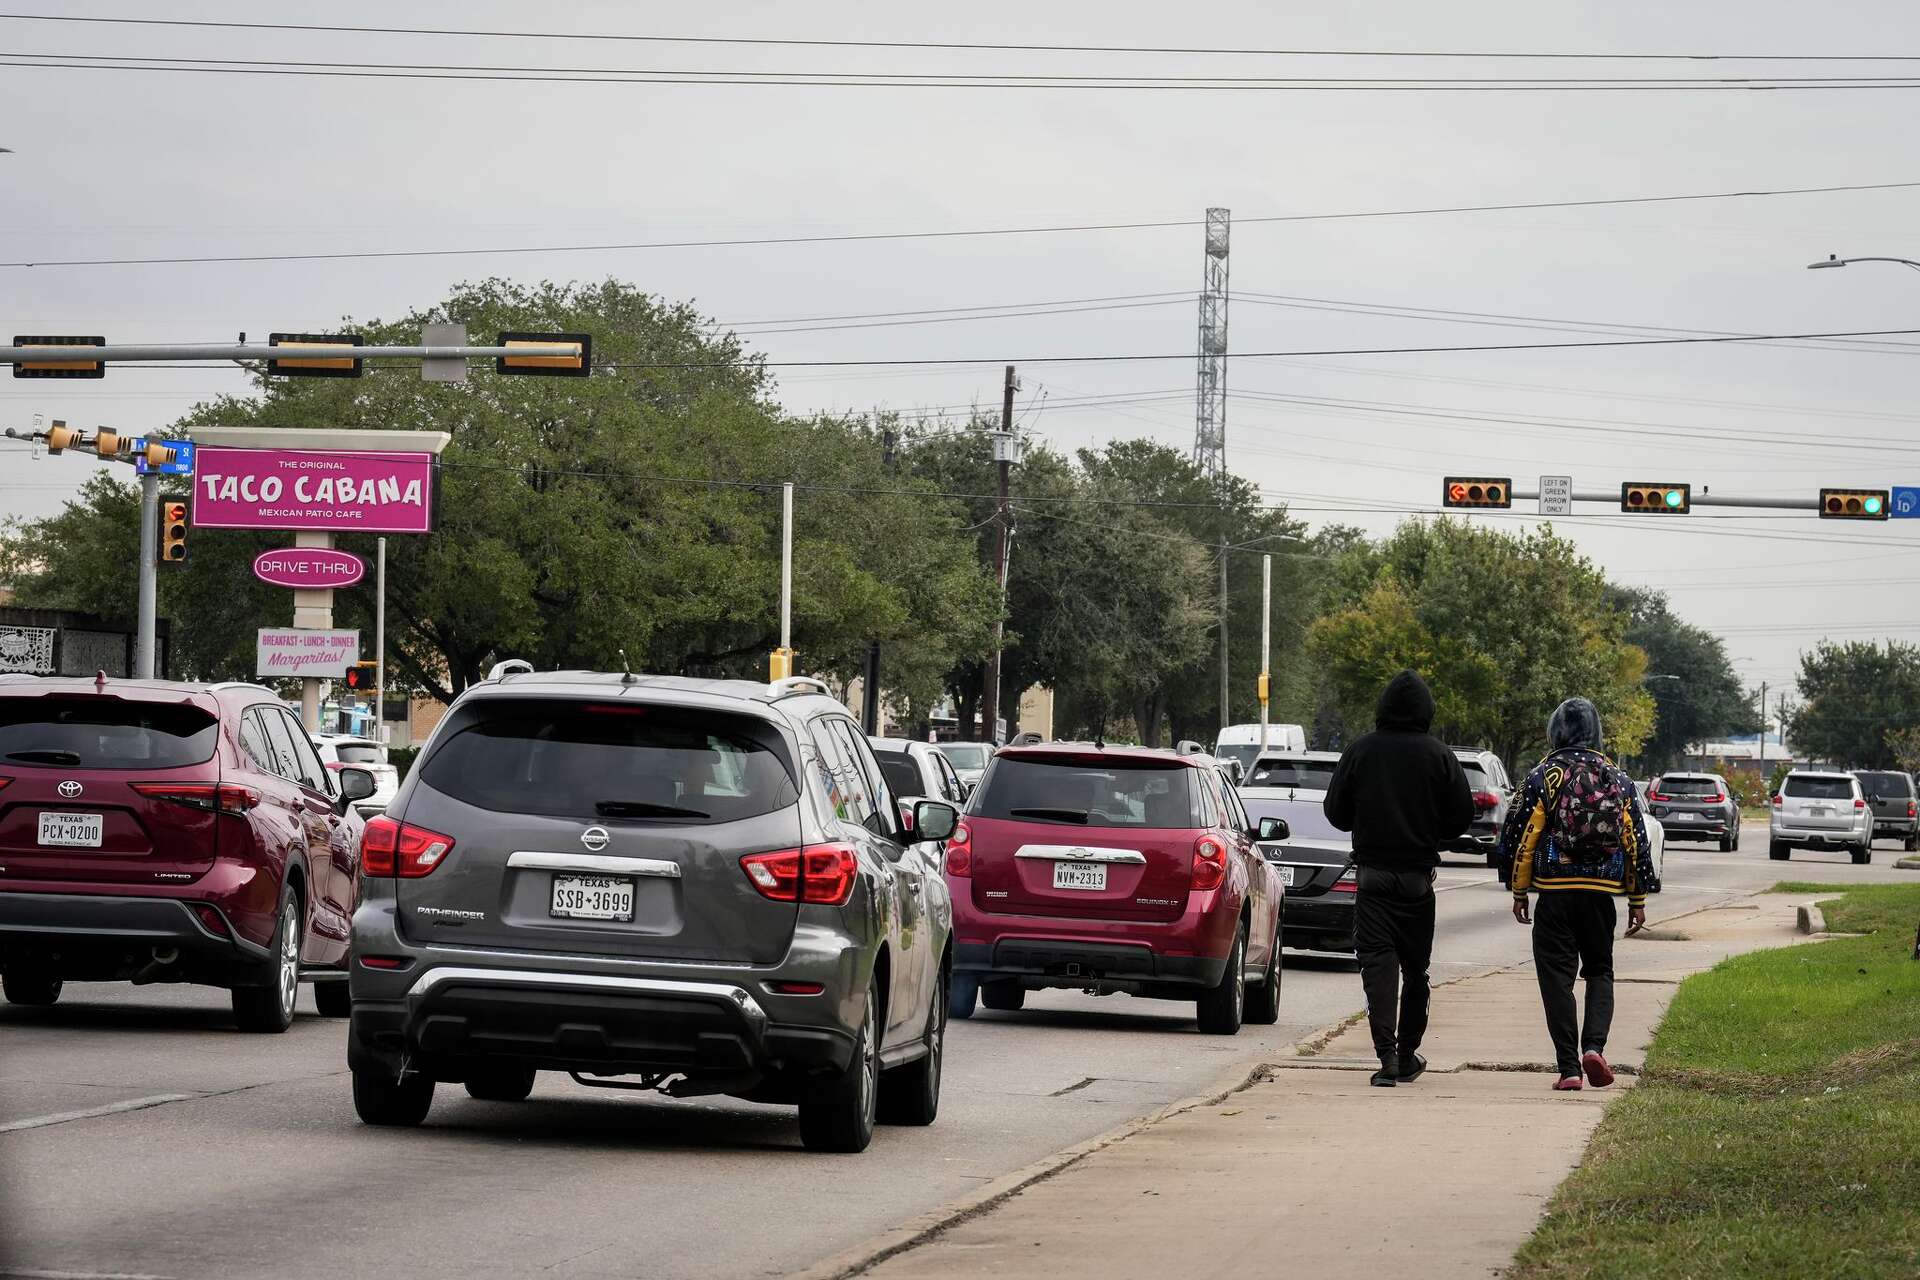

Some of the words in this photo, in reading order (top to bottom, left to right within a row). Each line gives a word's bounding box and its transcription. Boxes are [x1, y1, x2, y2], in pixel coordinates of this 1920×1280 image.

[300, 461, 345, 469] ORIGINAL
[202, 474, 282, 503] TACO
[294, 475, 421, 506] CABANA
[258, 509, 302, 517] MEXICAN
[306, 510, 333, 518] PATIO
[261, 561, 309, 573] DRIVE
[312, 562, 356, 575] THRU
[263, 635, 298, 646] BREAKFAST
[304, 636, 325, 647] LUNCH
[331, 637, 355, 647] DINNER
[268, 649, 345, 671] Margaritas!
[579, 879, 610, 888] TEXAS
[417, 906, 485, 920] PATHFINDER
